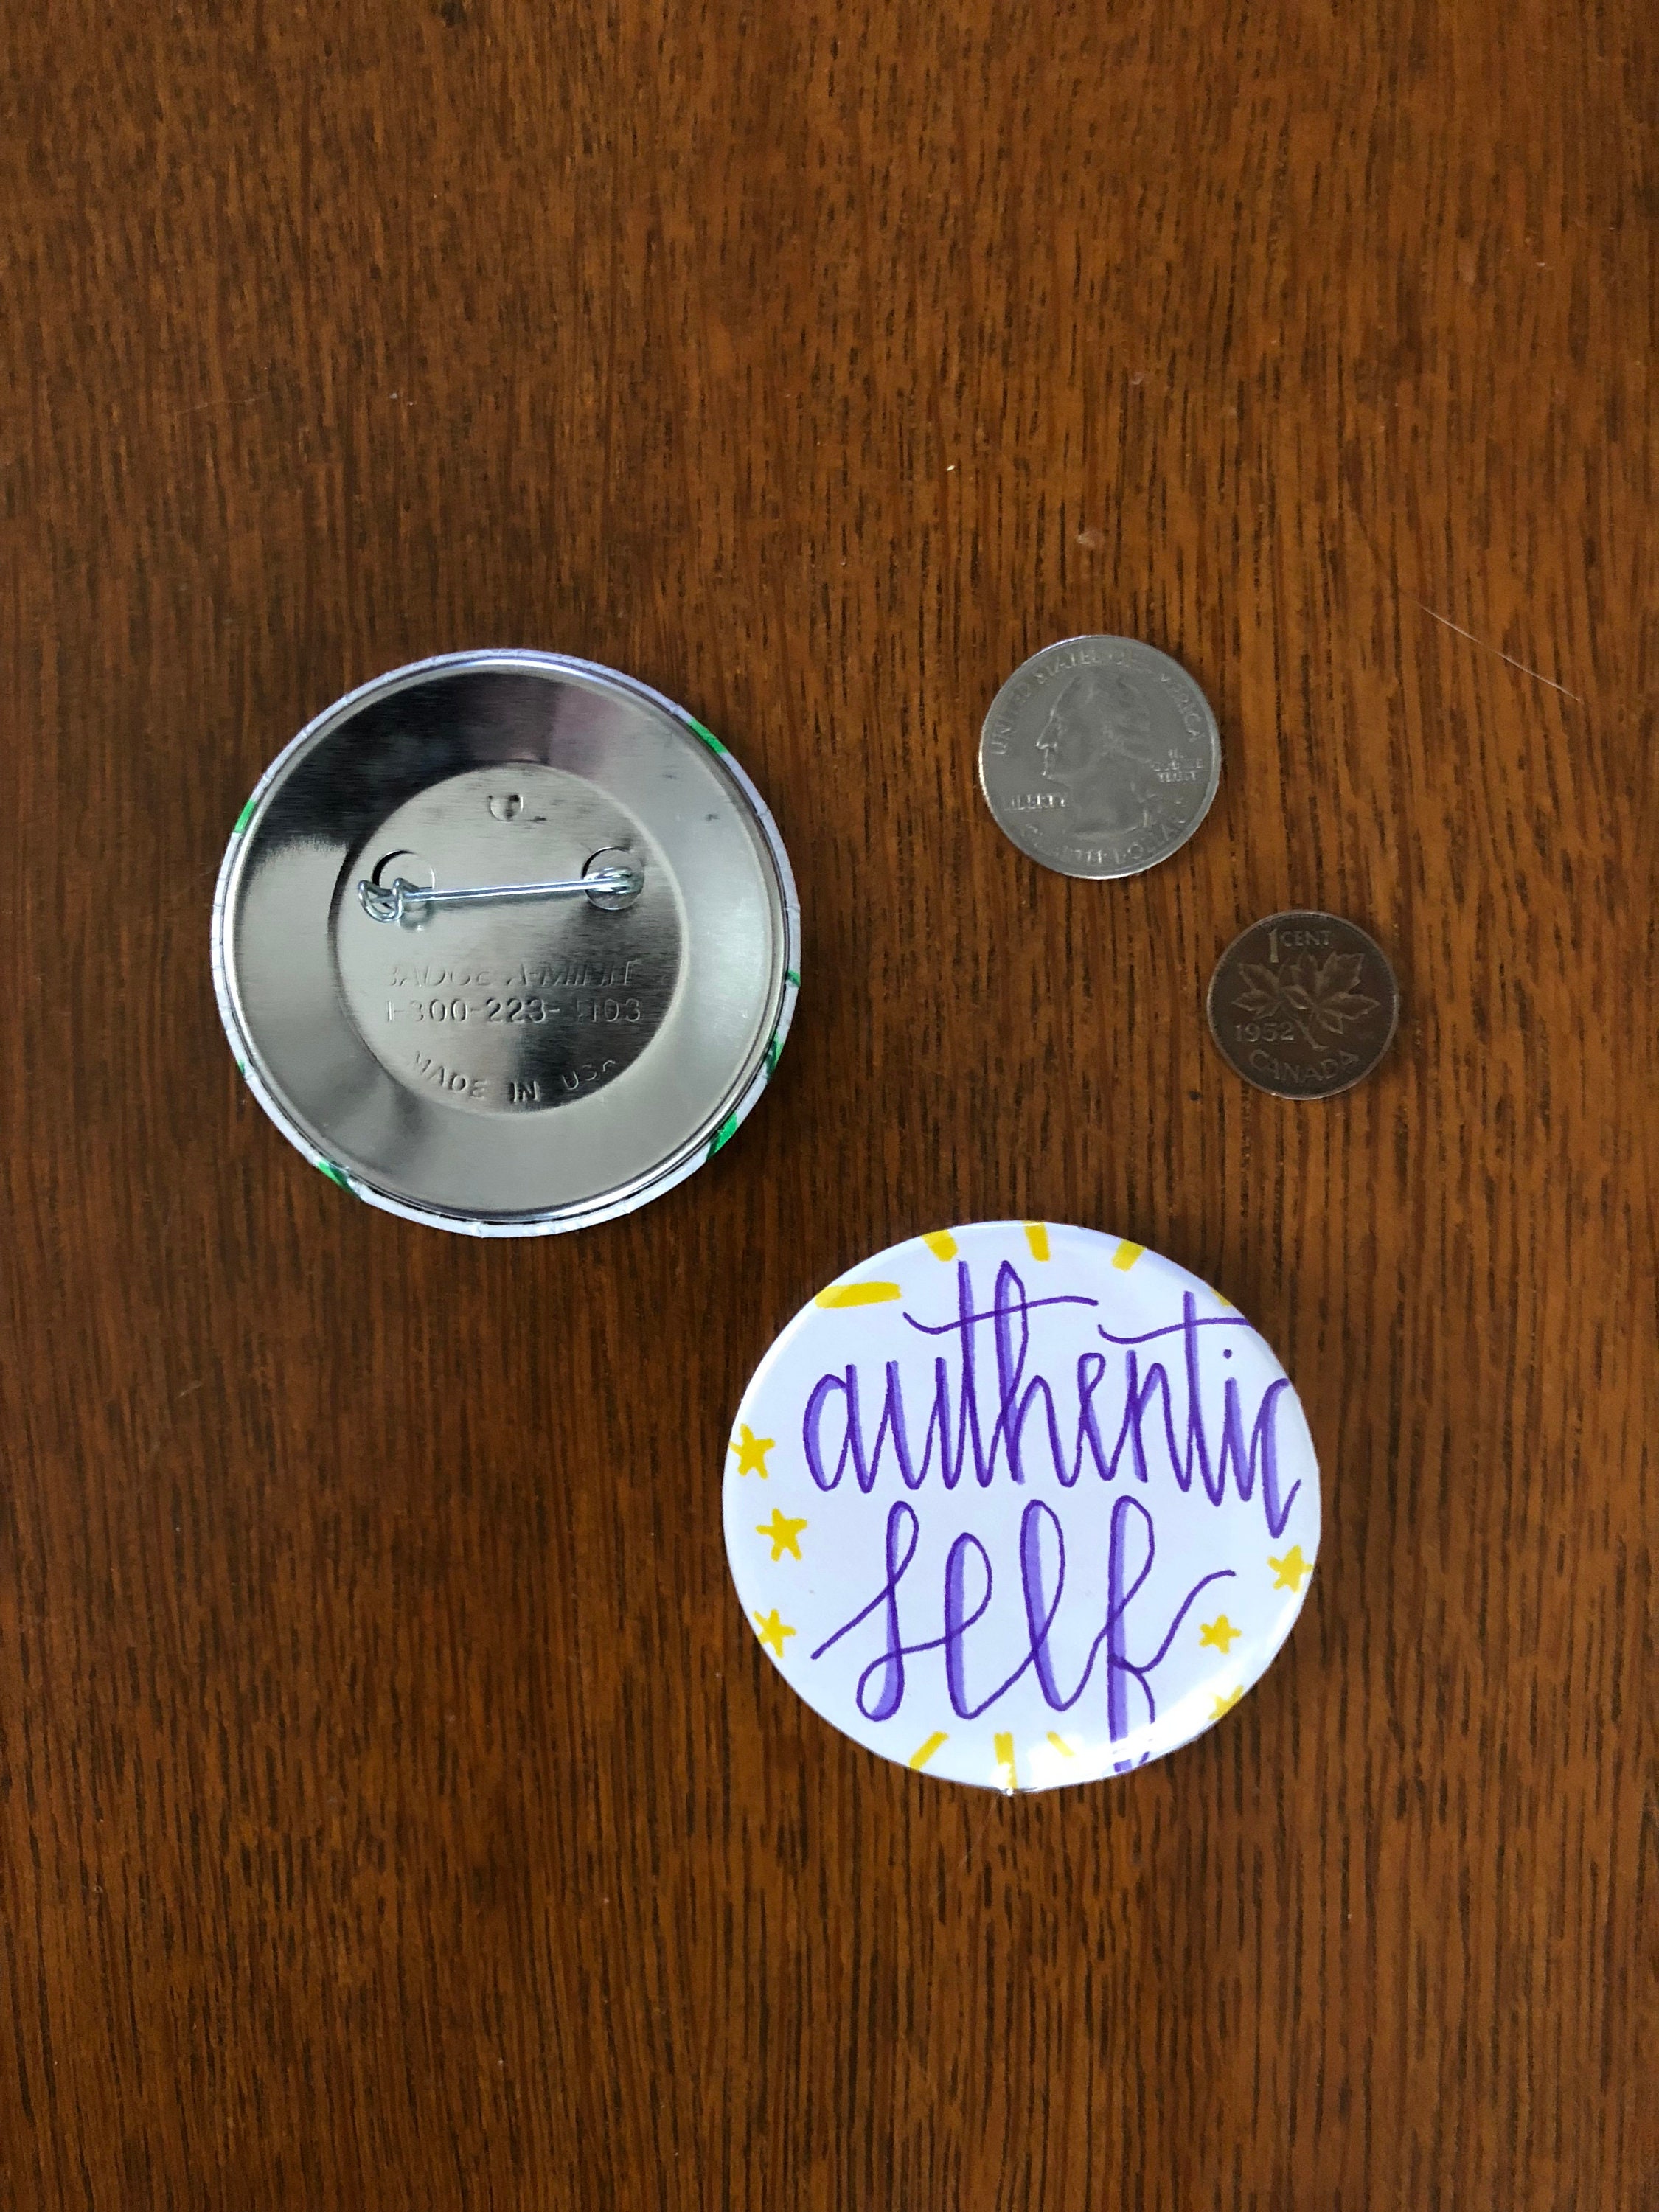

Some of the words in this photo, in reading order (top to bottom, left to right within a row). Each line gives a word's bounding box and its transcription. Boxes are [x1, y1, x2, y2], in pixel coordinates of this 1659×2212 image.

[1268, 928, 1279, 963] 1
[1279, 929, 1331, 947] CENT
[1235, 1022, 1295, 1042] 1952
[414, 1050, 487, 1099] MADE
[509, 1080, 540, 1102] IN
[1249, 1049, 1360, 1083] CANADA
[803, 1259, 1302, 1539] authentic
[810, 1495, 1237, 1773] self
